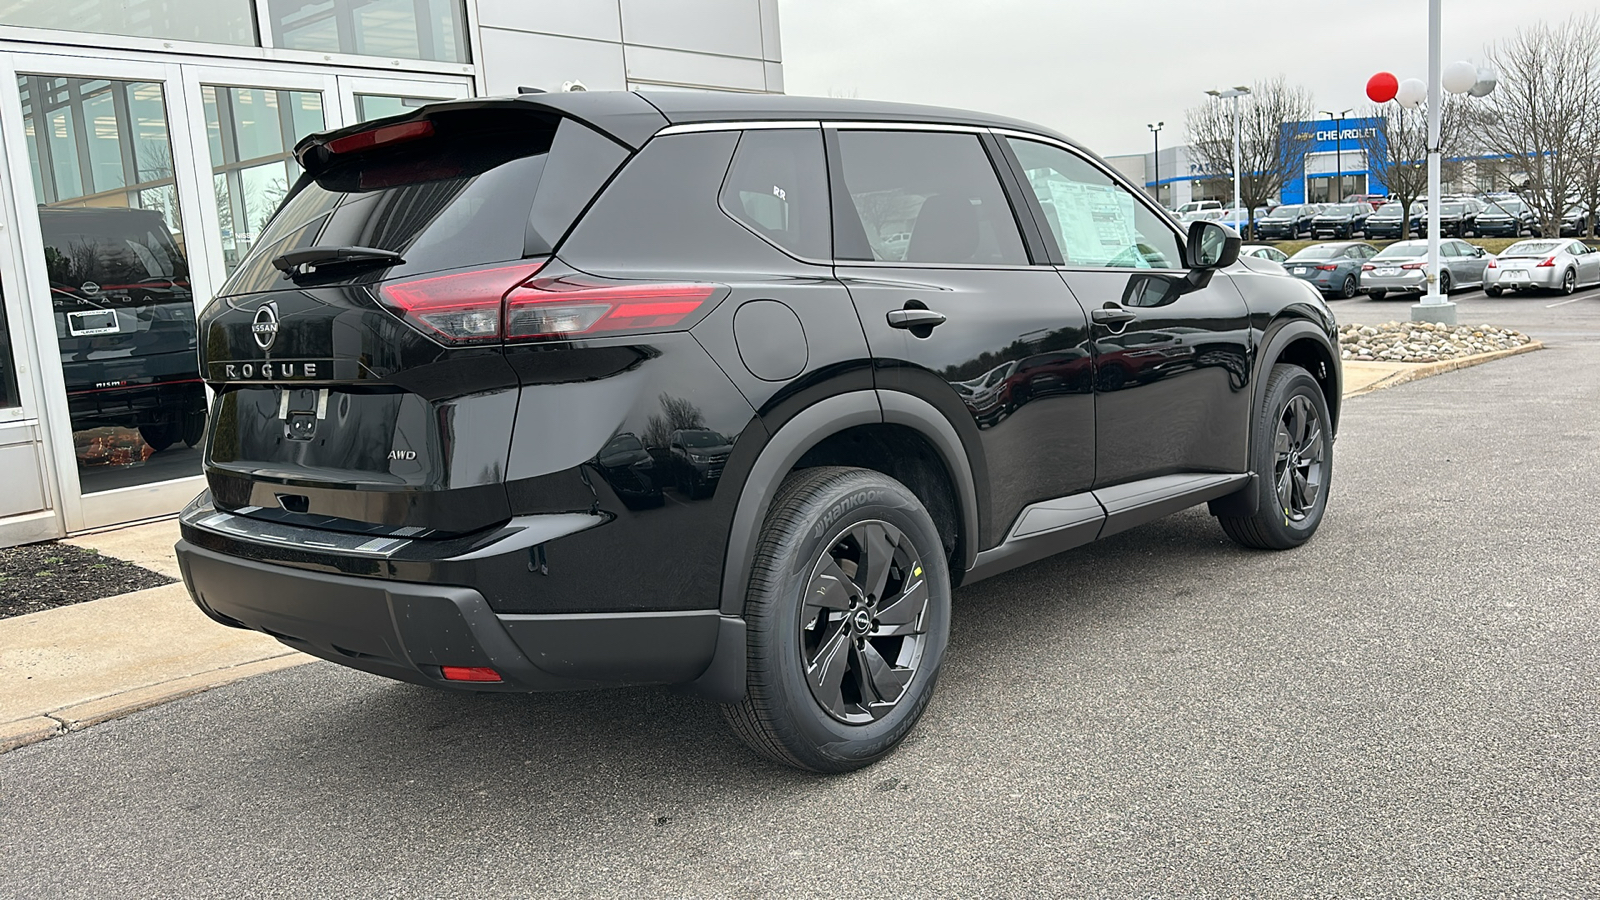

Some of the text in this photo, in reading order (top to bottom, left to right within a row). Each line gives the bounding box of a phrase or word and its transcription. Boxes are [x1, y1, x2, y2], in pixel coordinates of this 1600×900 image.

[1316, 127, 1377, 141] CHEVROLET
[773, 185, 786, 201] RR
[54, 295, 153, 307] RMADA
[225, 363, 317, 378] ROGUE
[387, 450, 416, 460] AWD
